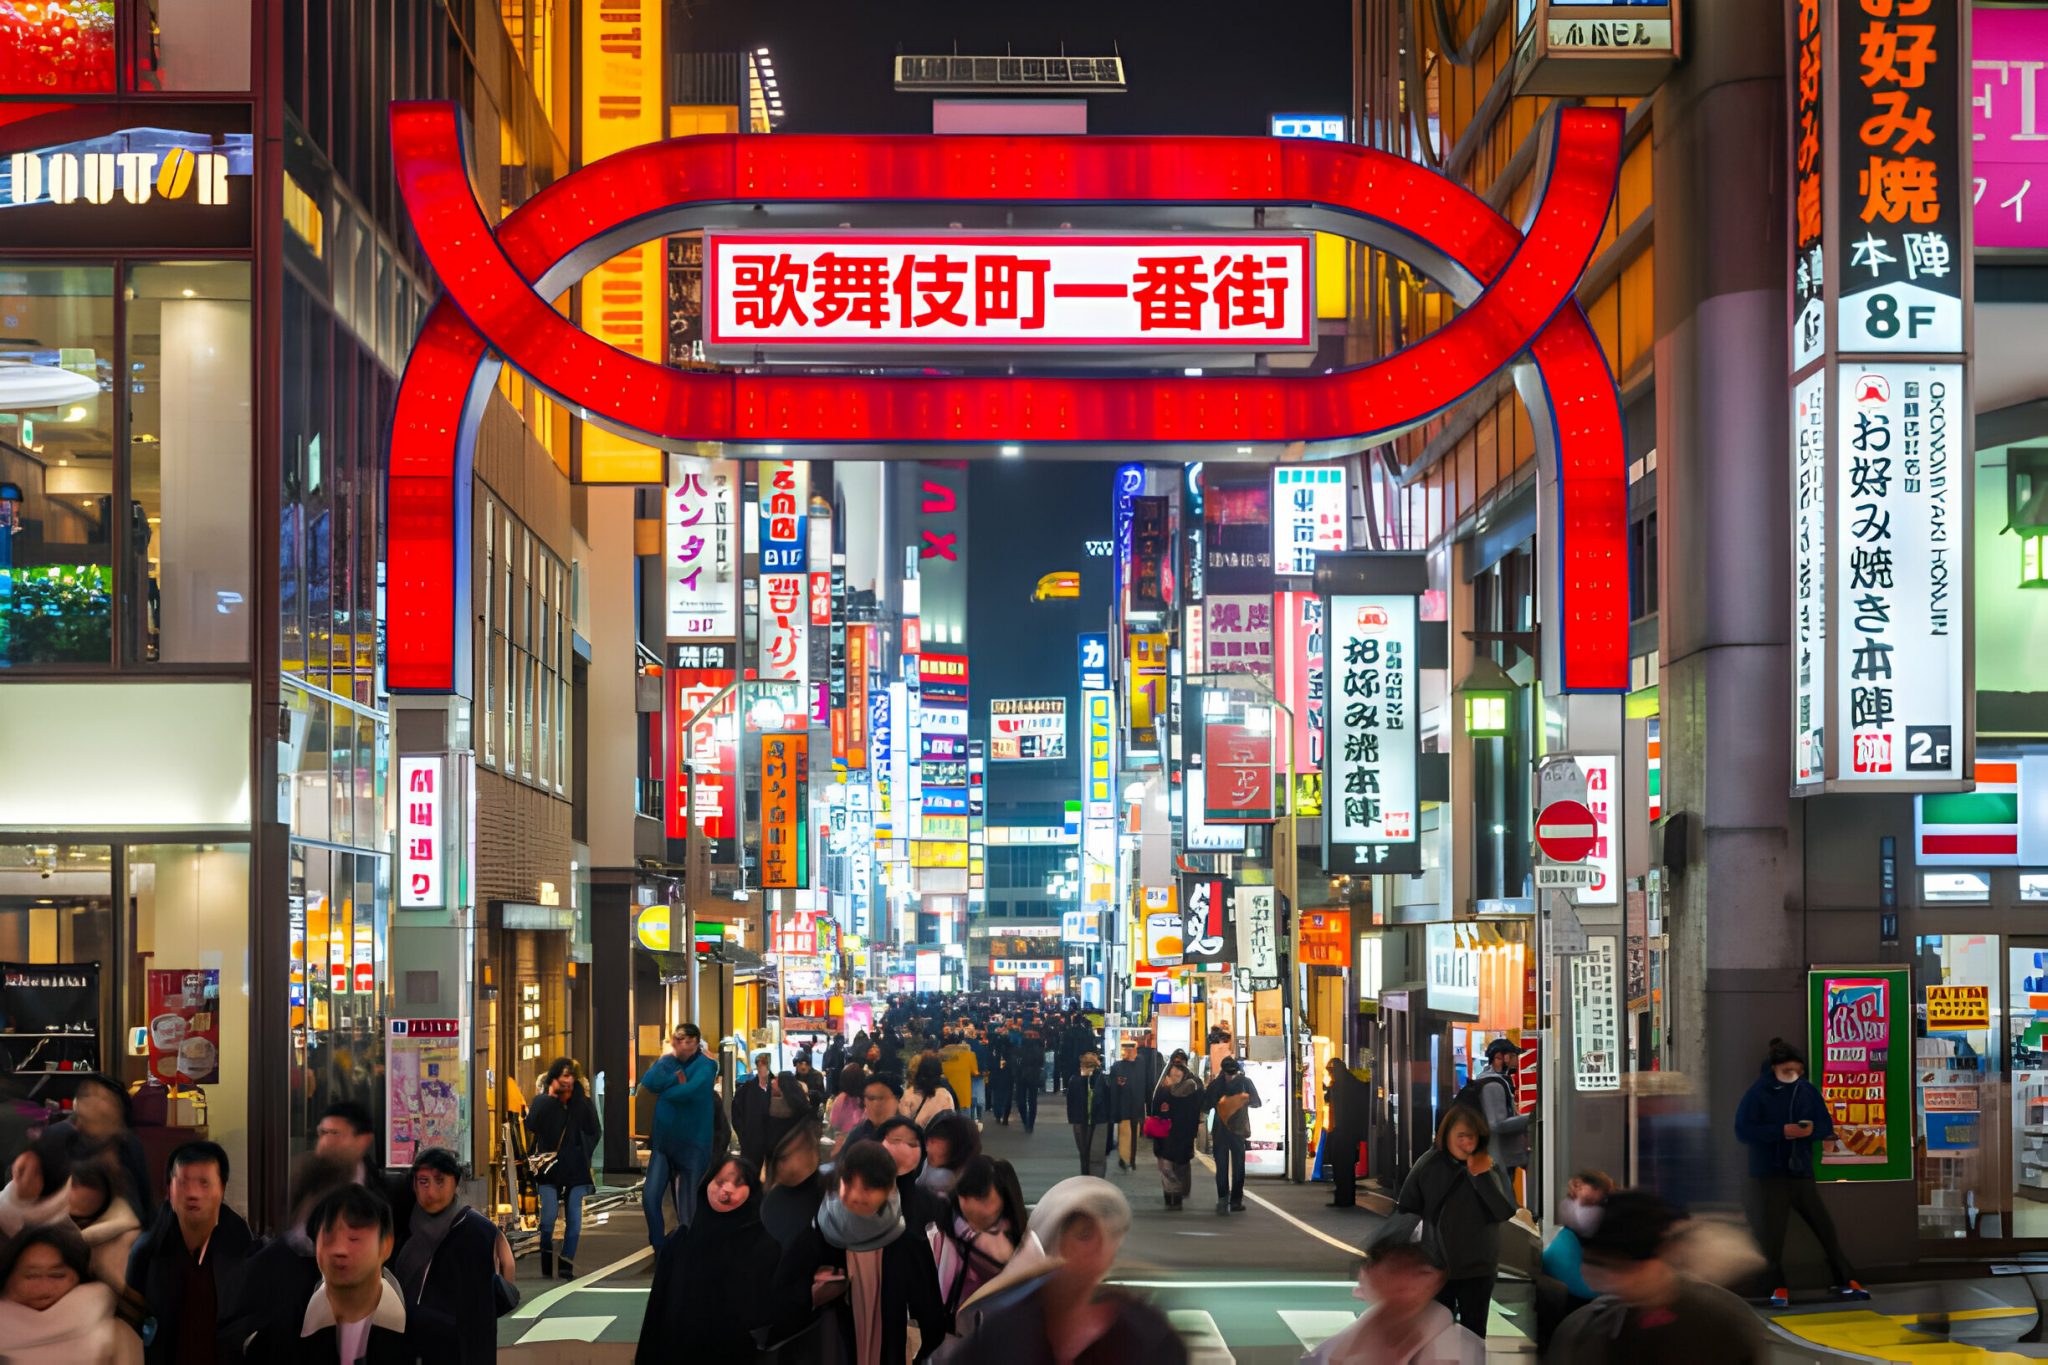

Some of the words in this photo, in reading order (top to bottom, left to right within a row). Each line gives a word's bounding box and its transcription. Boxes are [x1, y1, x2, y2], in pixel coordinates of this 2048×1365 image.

[1859, 0, 1941, 224] 好み焼
[11, 147, 229, 206] DOUTOR
[1851, 230, 1950, 280] 本陣
[732, 252, 1288, 331] 歌舞伎町一番街
[1865, 293, 1937, 340] 8F
[1850, 411, 1895, 731] お好み焼き本陣
[1910, 731, 1950, 767] 2F
